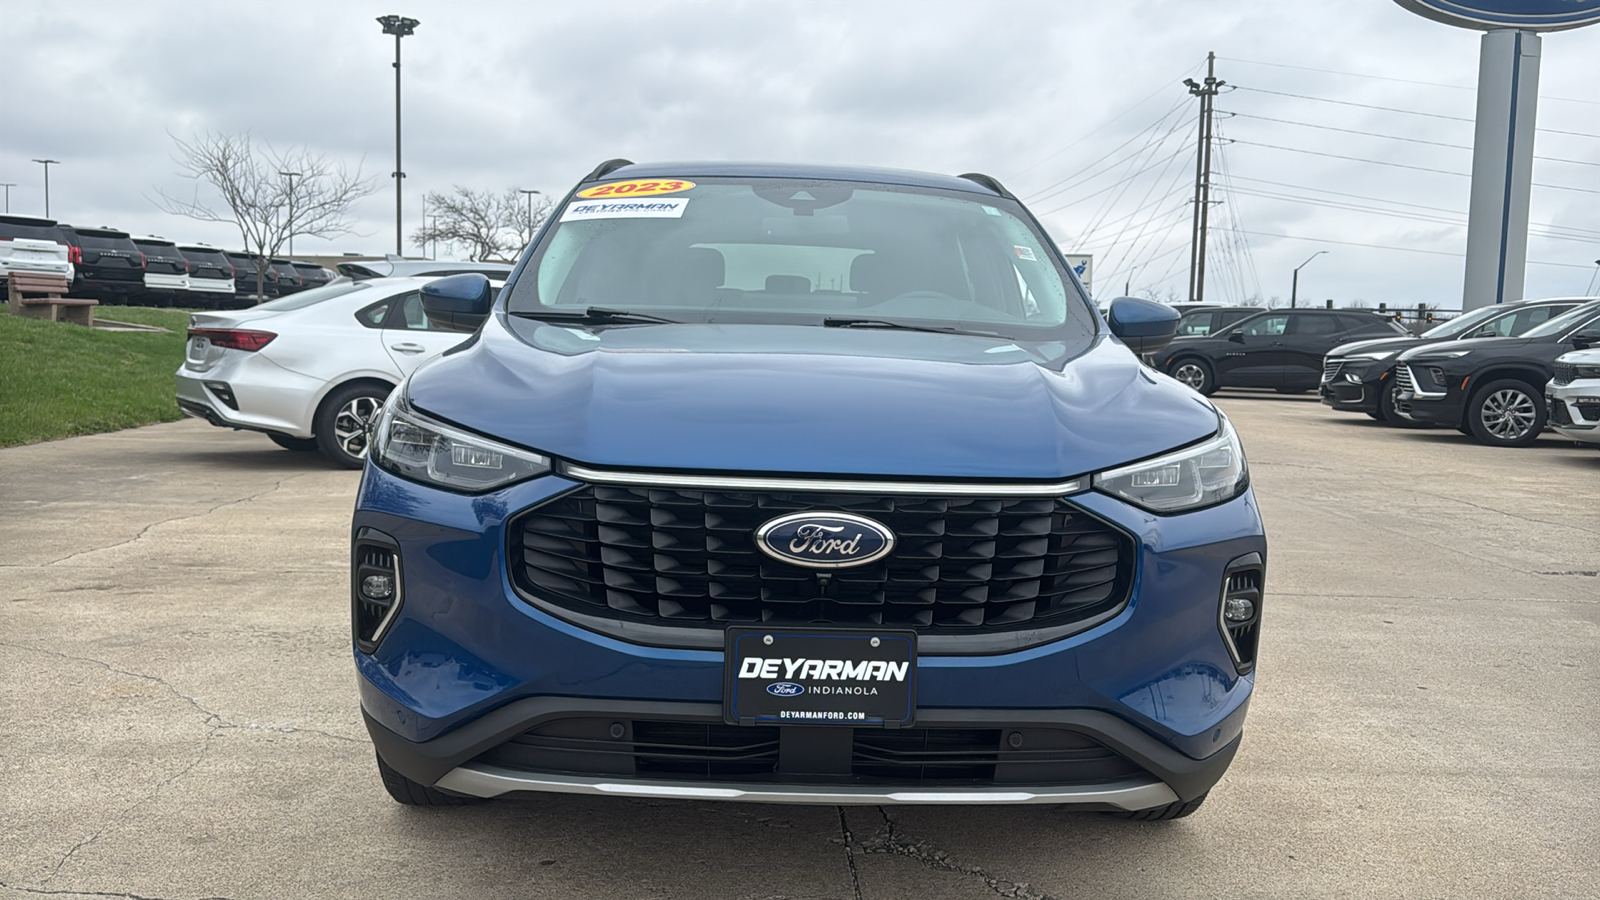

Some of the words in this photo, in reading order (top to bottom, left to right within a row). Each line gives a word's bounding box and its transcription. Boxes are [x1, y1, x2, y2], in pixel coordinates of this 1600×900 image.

[588, 181, 685, 197] 2023
[573, 203, 680, 213] DEYARMAN
[789, 523, 863, 555] Ford
[737, 656, 910, 682] DEYARMAN
[773, 683, 797, 695] Ford
[808, 686, 878, 696] INDIANOLA
[780, 710, 866, 720] DEYARMANFORD.COM
